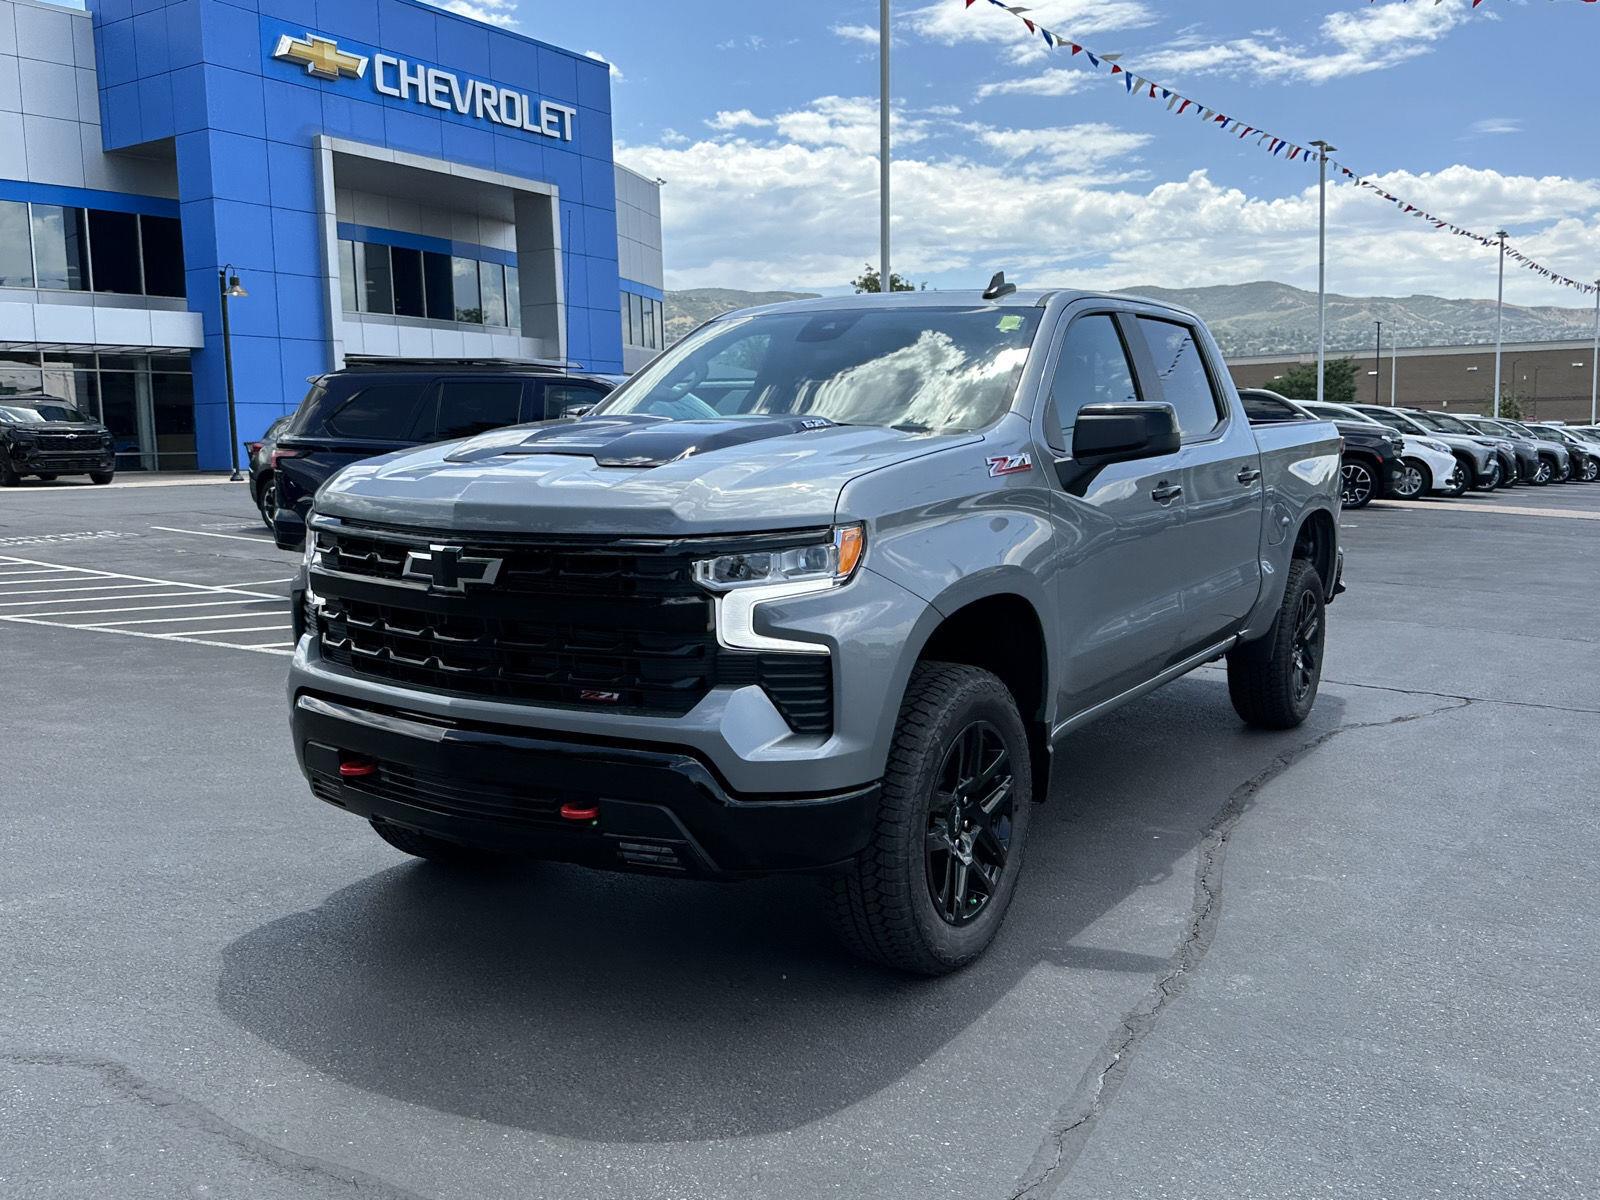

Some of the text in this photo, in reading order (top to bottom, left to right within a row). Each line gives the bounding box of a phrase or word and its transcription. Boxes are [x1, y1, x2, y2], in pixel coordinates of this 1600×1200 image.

[373, 53, 577, 141] CHEVROLET
[985, 452, 1033, 477] Z71
[579, 689, 620, 701] Z71
